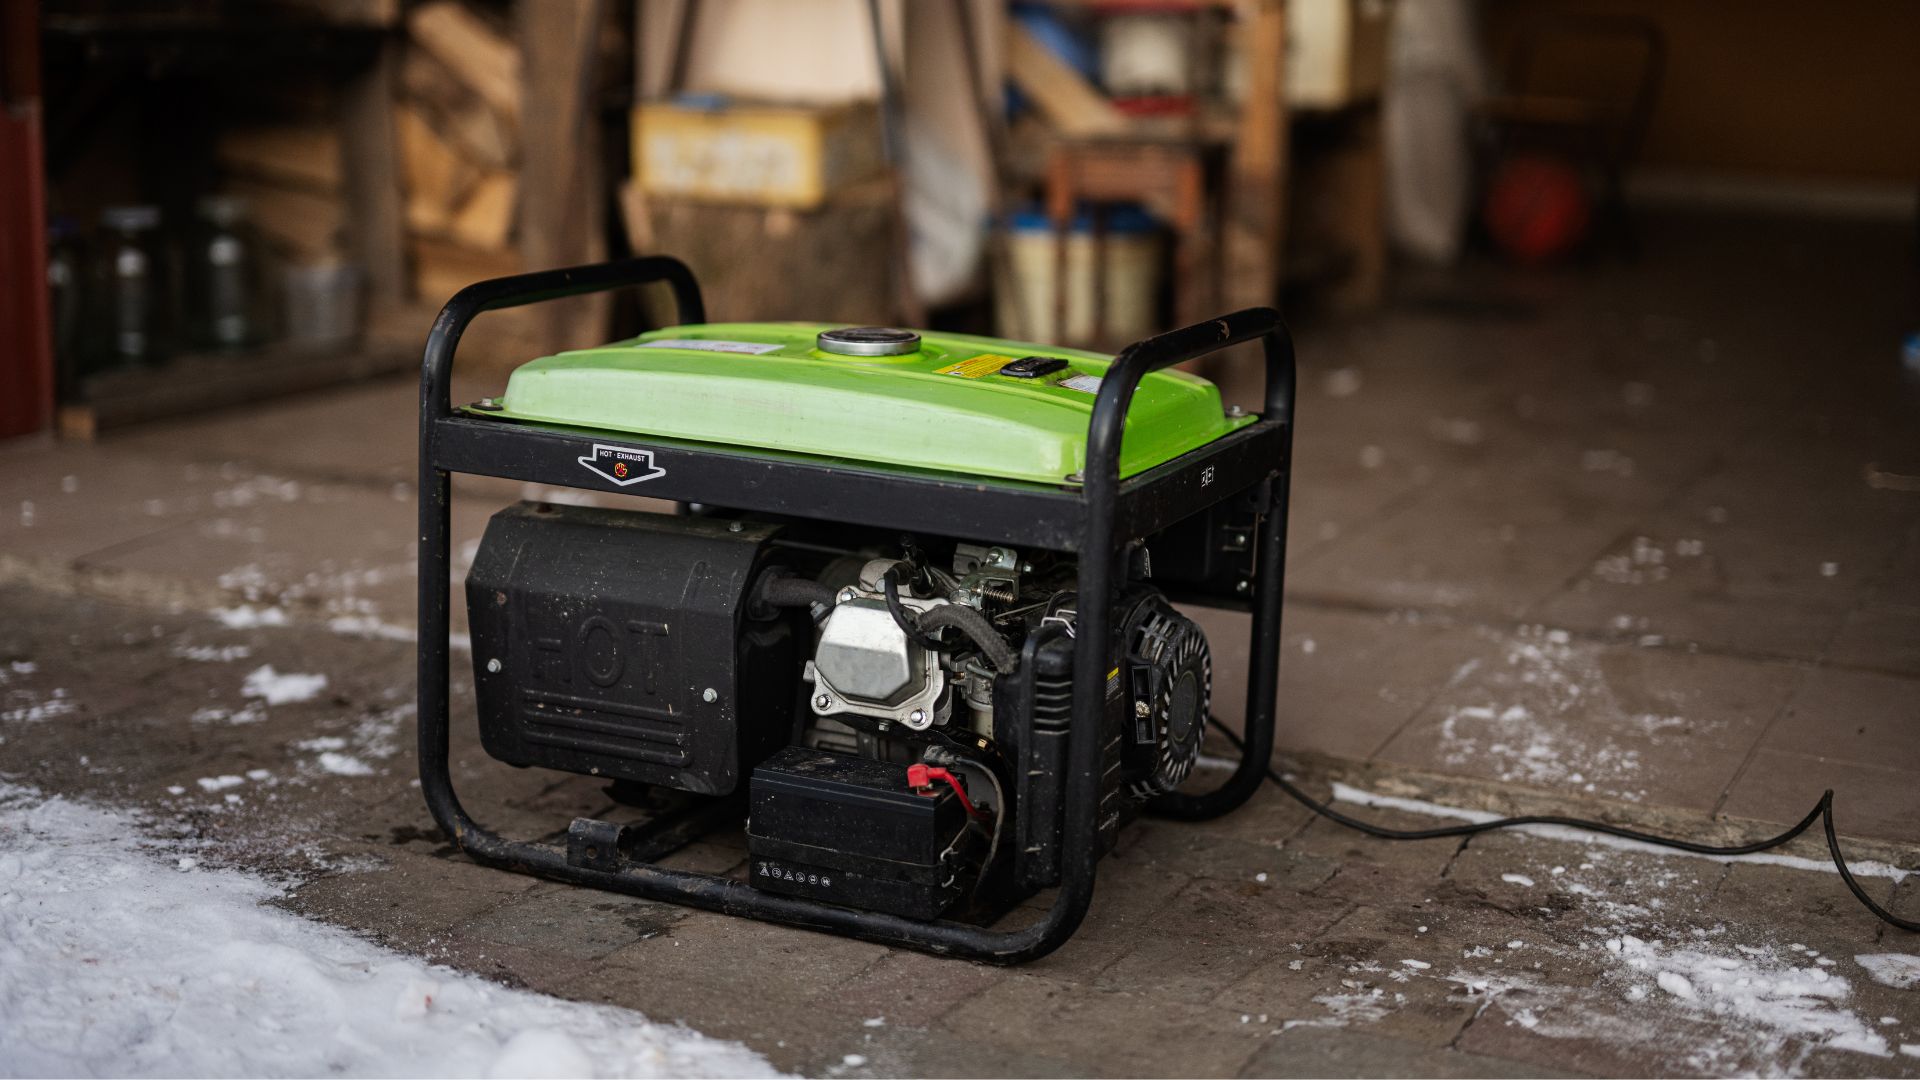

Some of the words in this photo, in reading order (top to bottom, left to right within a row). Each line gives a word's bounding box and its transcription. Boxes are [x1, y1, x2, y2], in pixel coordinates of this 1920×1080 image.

[599, 449, 613, 458] HOT
[616, 452, 646, 463] EXHAUST
[530, 615, 670, 695] HOT
